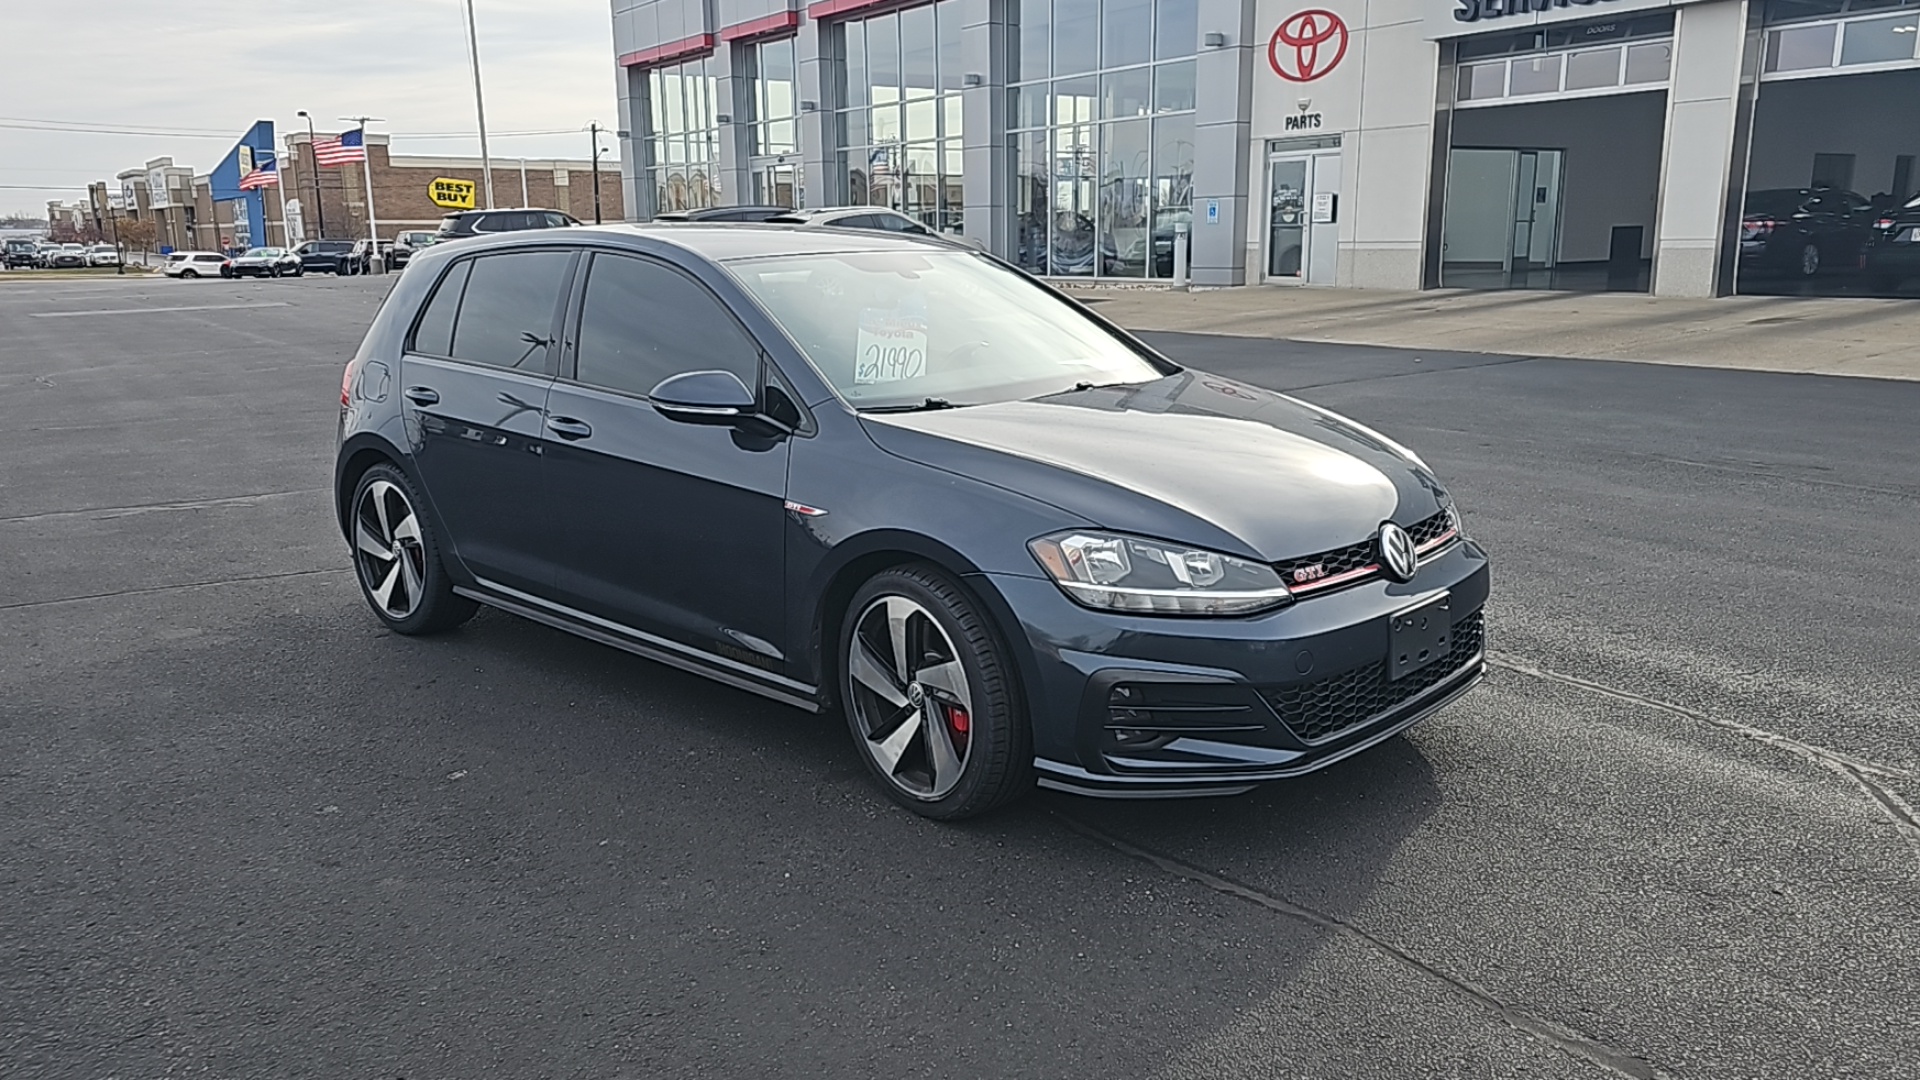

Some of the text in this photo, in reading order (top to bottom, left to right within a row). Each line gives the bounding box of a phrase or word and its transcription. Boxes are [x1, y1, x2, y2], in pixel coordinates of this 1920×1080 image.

[1586, 23, 1616, 35] DOORS
[1285, 113, 1322, 131] PARTS
[435, 181, 473, 194] BEST
[436, 192, 470, 204] BUY
[873, 328, 914, 340] Toyota
[1293, 563, 1325, 583] GTI
